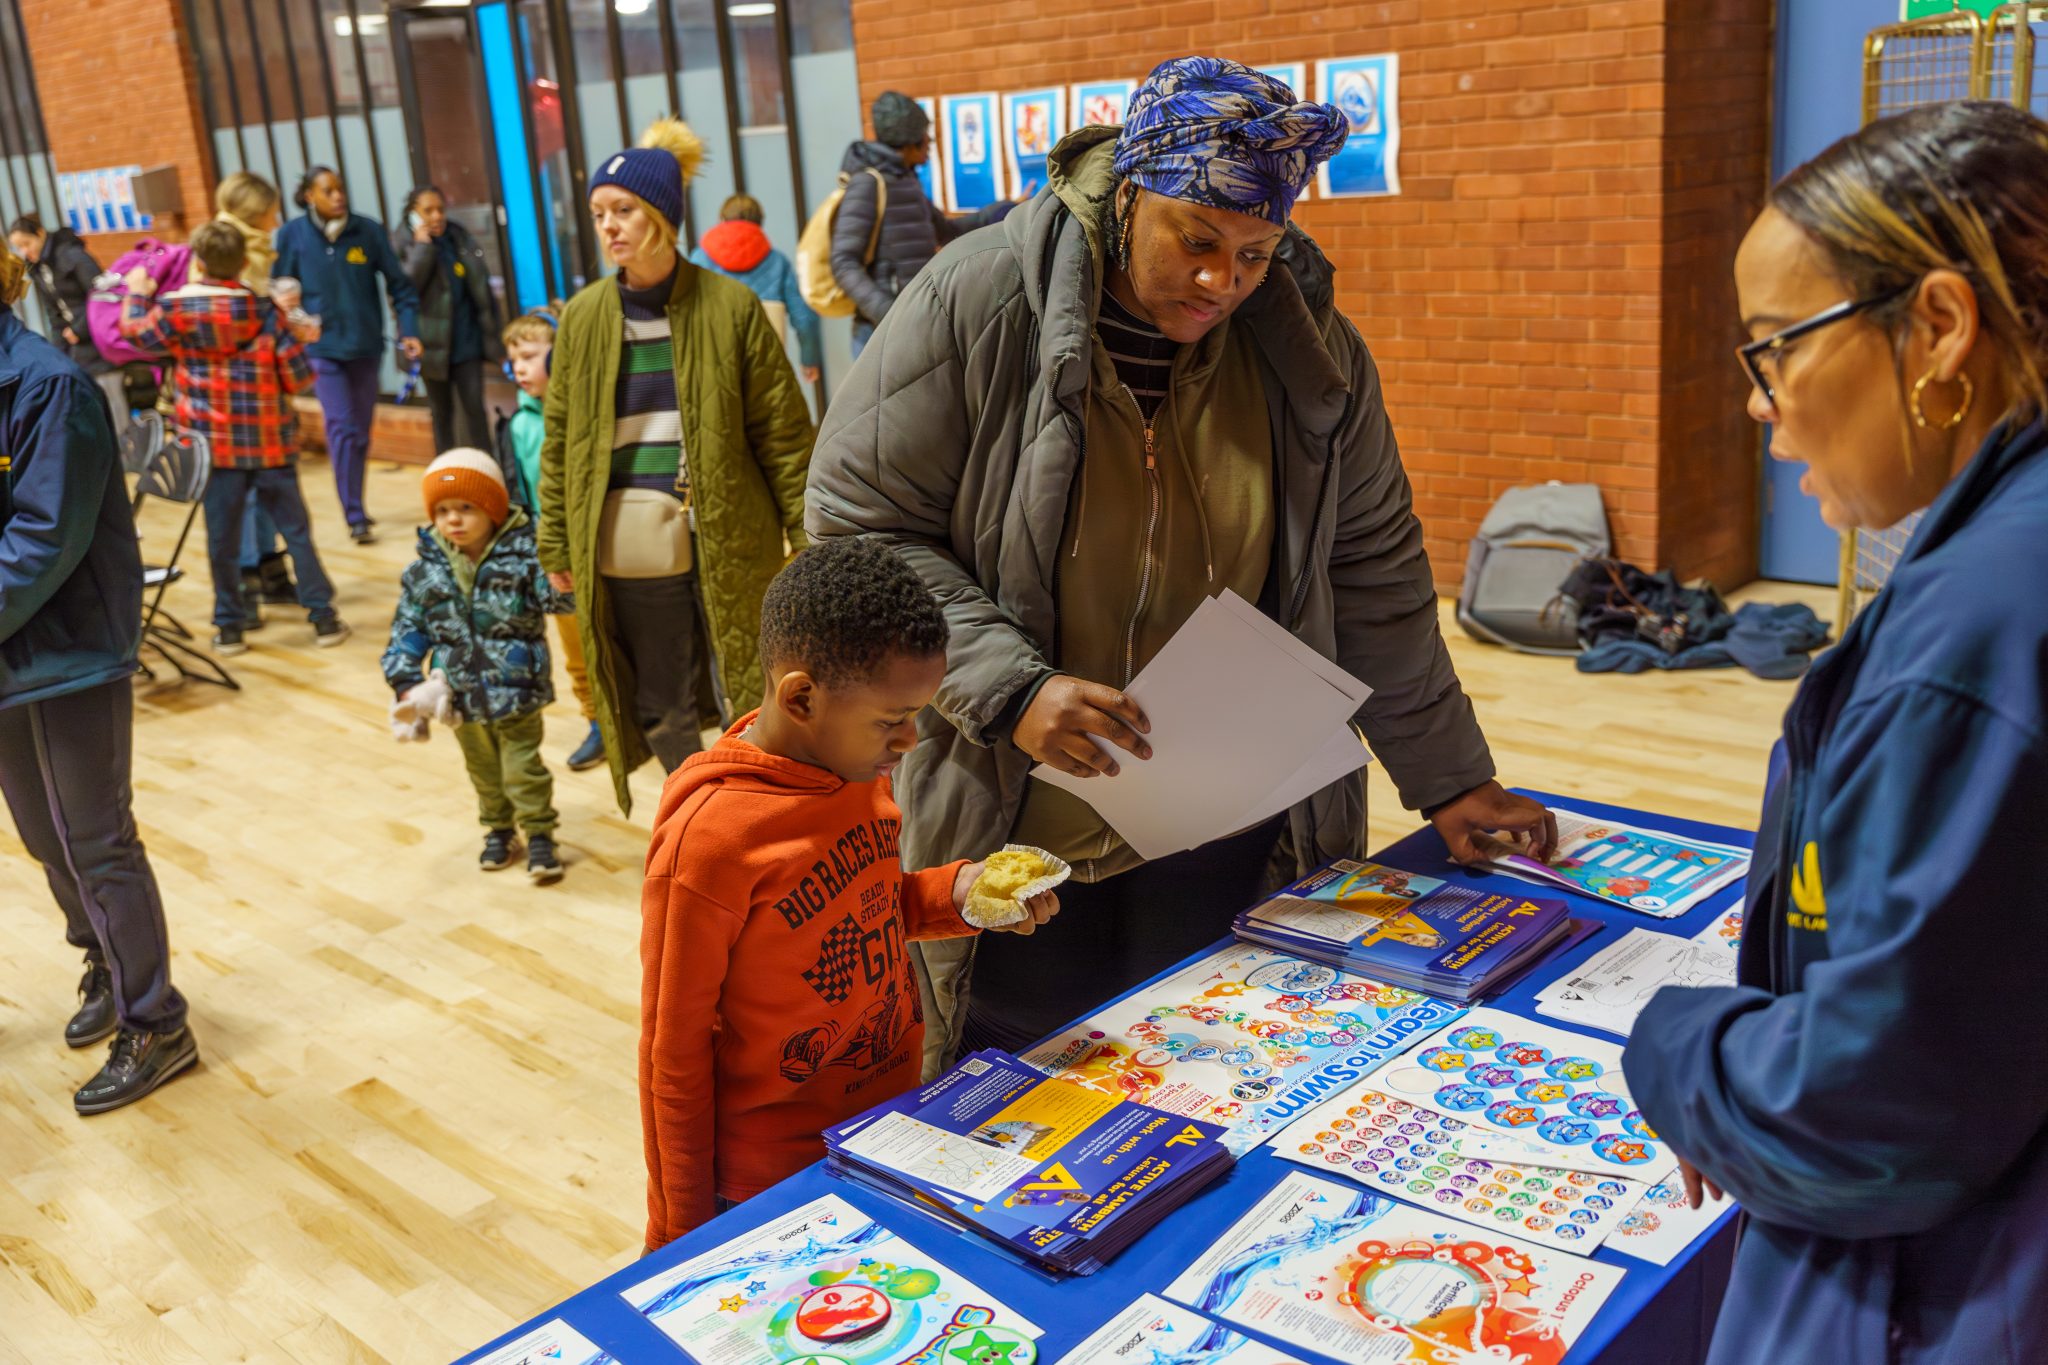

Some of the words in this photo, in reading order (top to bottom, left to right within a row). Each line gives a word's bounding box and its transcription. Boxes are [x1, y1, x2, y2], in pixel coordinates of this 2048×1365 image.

[772, 874, 826, 930] BIG
[811, 824, 877, 900] RACES
[860, 879, 885, 906] READY
[1479, 896, 1501, 907] Swim
[1489, 898, 1512, 912] Active
[861, 897, 890, 924] STEADY
[1457, 907, 1483, 923] School
[1461, 912, 1490, 932] Lambeth
[1485, 925, 1515, 944] ACTIVE
[1449, 944, 1488, 969] LAMBETH
[1368, 997, 1458, 1050] Learn
[1346, 1052, 1383, 1068] to
[951, 1073, 966, 1082] Scan
[1024, 1078, 1036, 1086] How
[919, 1094, 932, 1103] code
[920, 1087, 935, 1096] more.
[1002, 1089, 1018, 1101] apply?
[1265, 1064, 1359, 1119] Swim
[1186, 1094, 1213, 1112] Learn
[1141, 1117, 1168, 1134] Work
[1117, 1136, 1140, 1152] with
[1103, 1154, 1118, 1164] us
[1123, 1156, 1158, 1181] Leisure
[1130, 1160, 1171, 1191] ACTIVE
[1109, 1182, 1126, 1193] for
[1093, 1194, 1108, 1204] all
[1078, 1191, 1133, 1232] LAMBETH
[1428, 1280, 1467, 1319] Certificate
[1555, 1272, 1594, 1312] Octopus
